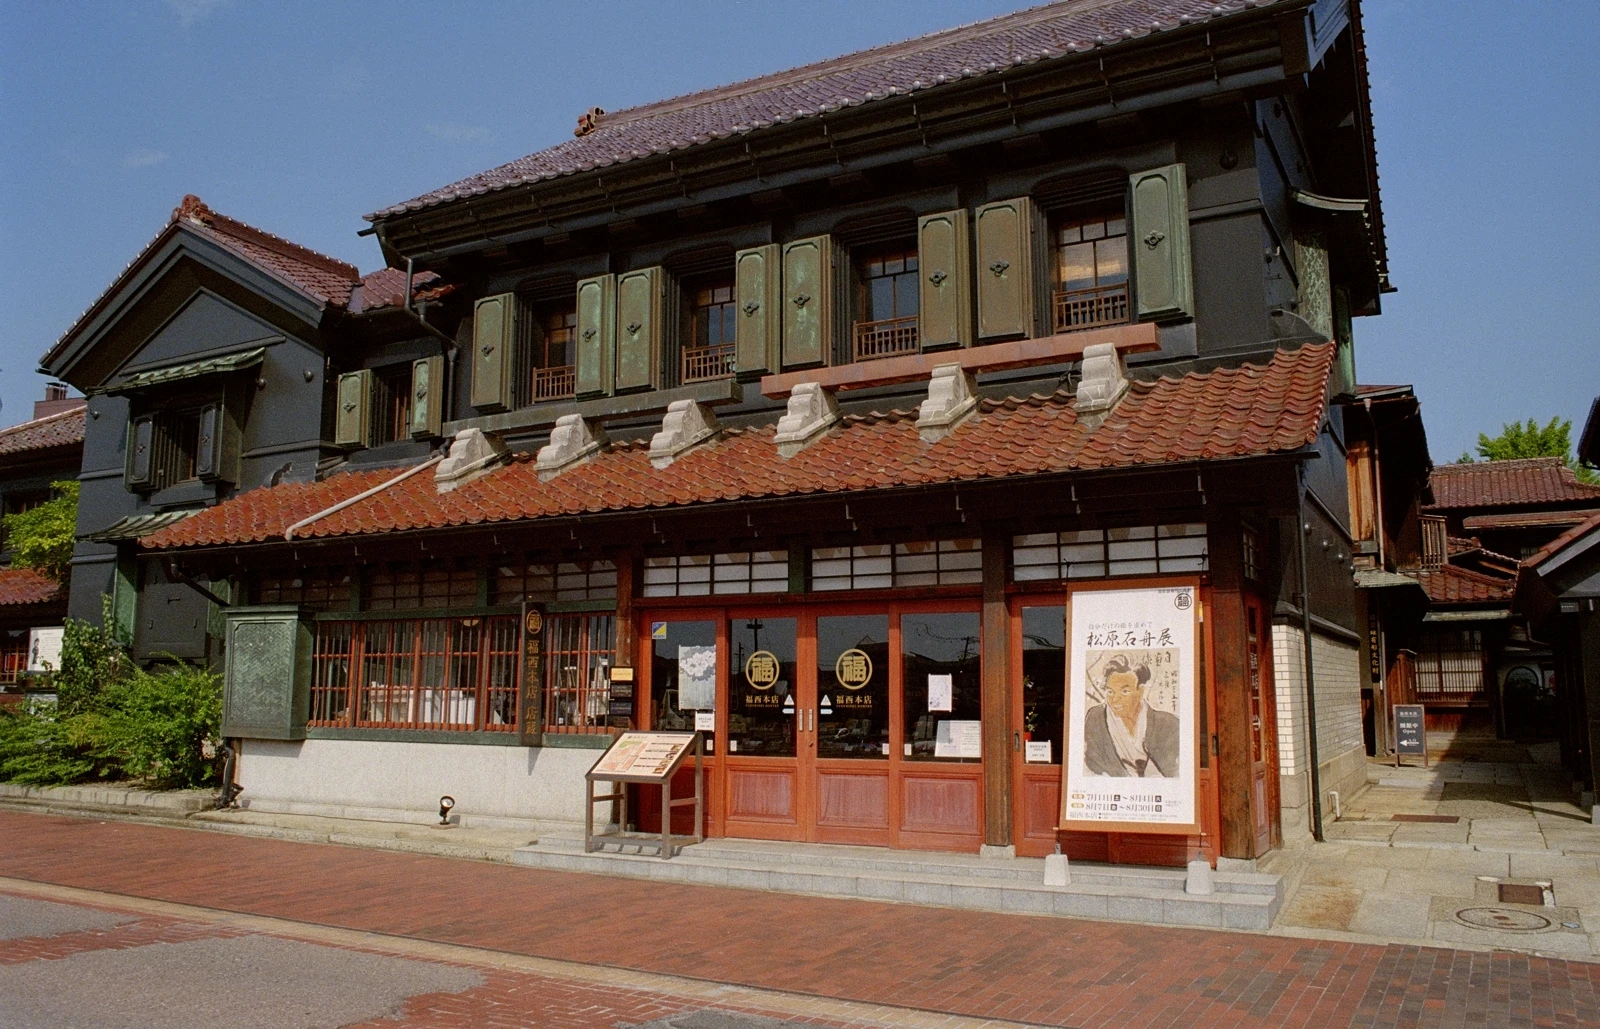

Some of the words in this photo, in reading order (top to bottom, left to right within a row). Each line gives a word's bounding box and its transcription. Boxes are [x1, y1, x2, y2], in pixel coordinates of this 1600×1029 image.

[1087, 628, 1174, 648] 松原石舟展
[526, 640, 539, 699] 福西本店
[745, 694, 779, 704] 福西本店
[836, 695, 872, 704] 福西本店
